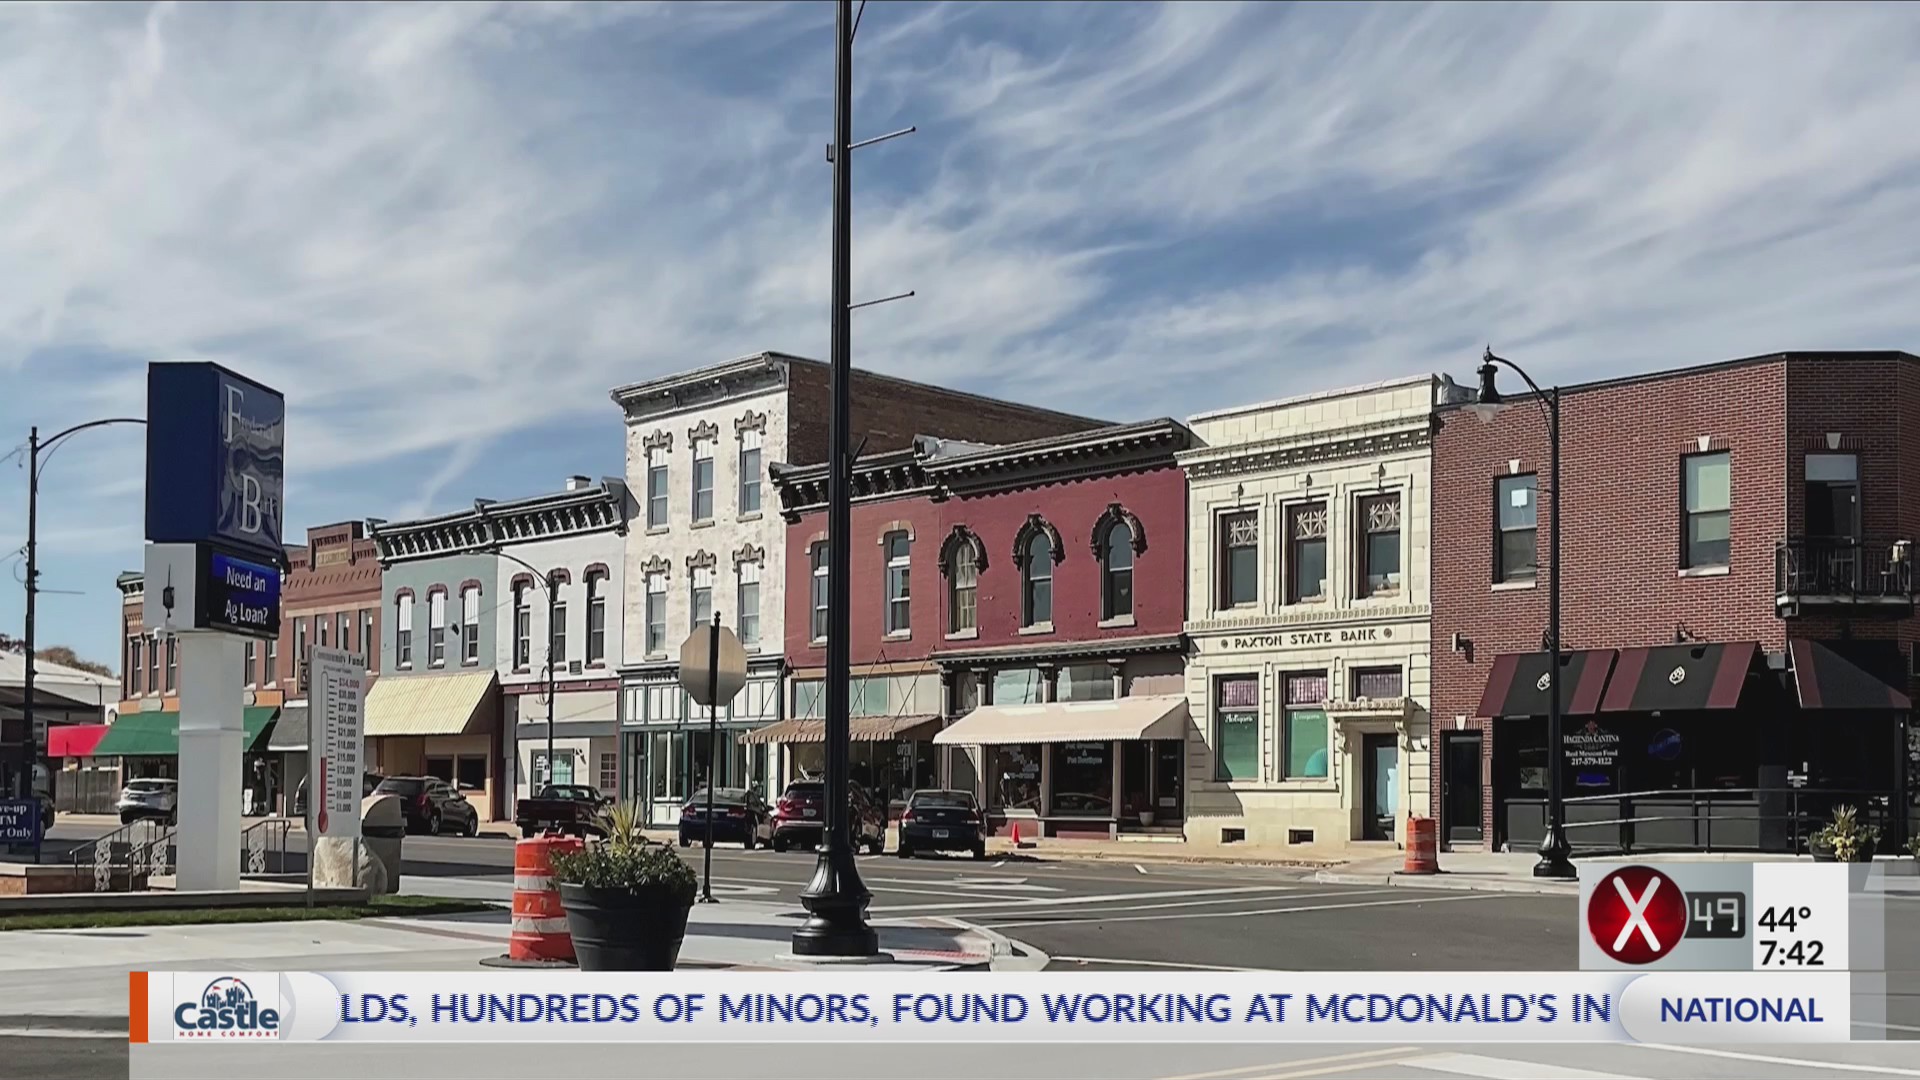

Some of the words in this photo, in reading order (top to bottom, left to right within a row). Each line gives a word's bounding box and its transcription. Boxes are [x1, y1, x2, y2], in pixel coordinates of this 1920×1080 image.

[226, 566, 252, 590] Need
[253, 574, 266, 592] an
[225, 600, 238, 624] Ag
[240, 602, 269, 625] Loan?
[1234, 636, 1283, 649] PAXTON
[1290, 632, 1332, 645] STATE
[1340, 628, 1378, 642] BANK
[1593, 734, 1620, 743] CANTINA
[6, 827, 32, 840] Only
